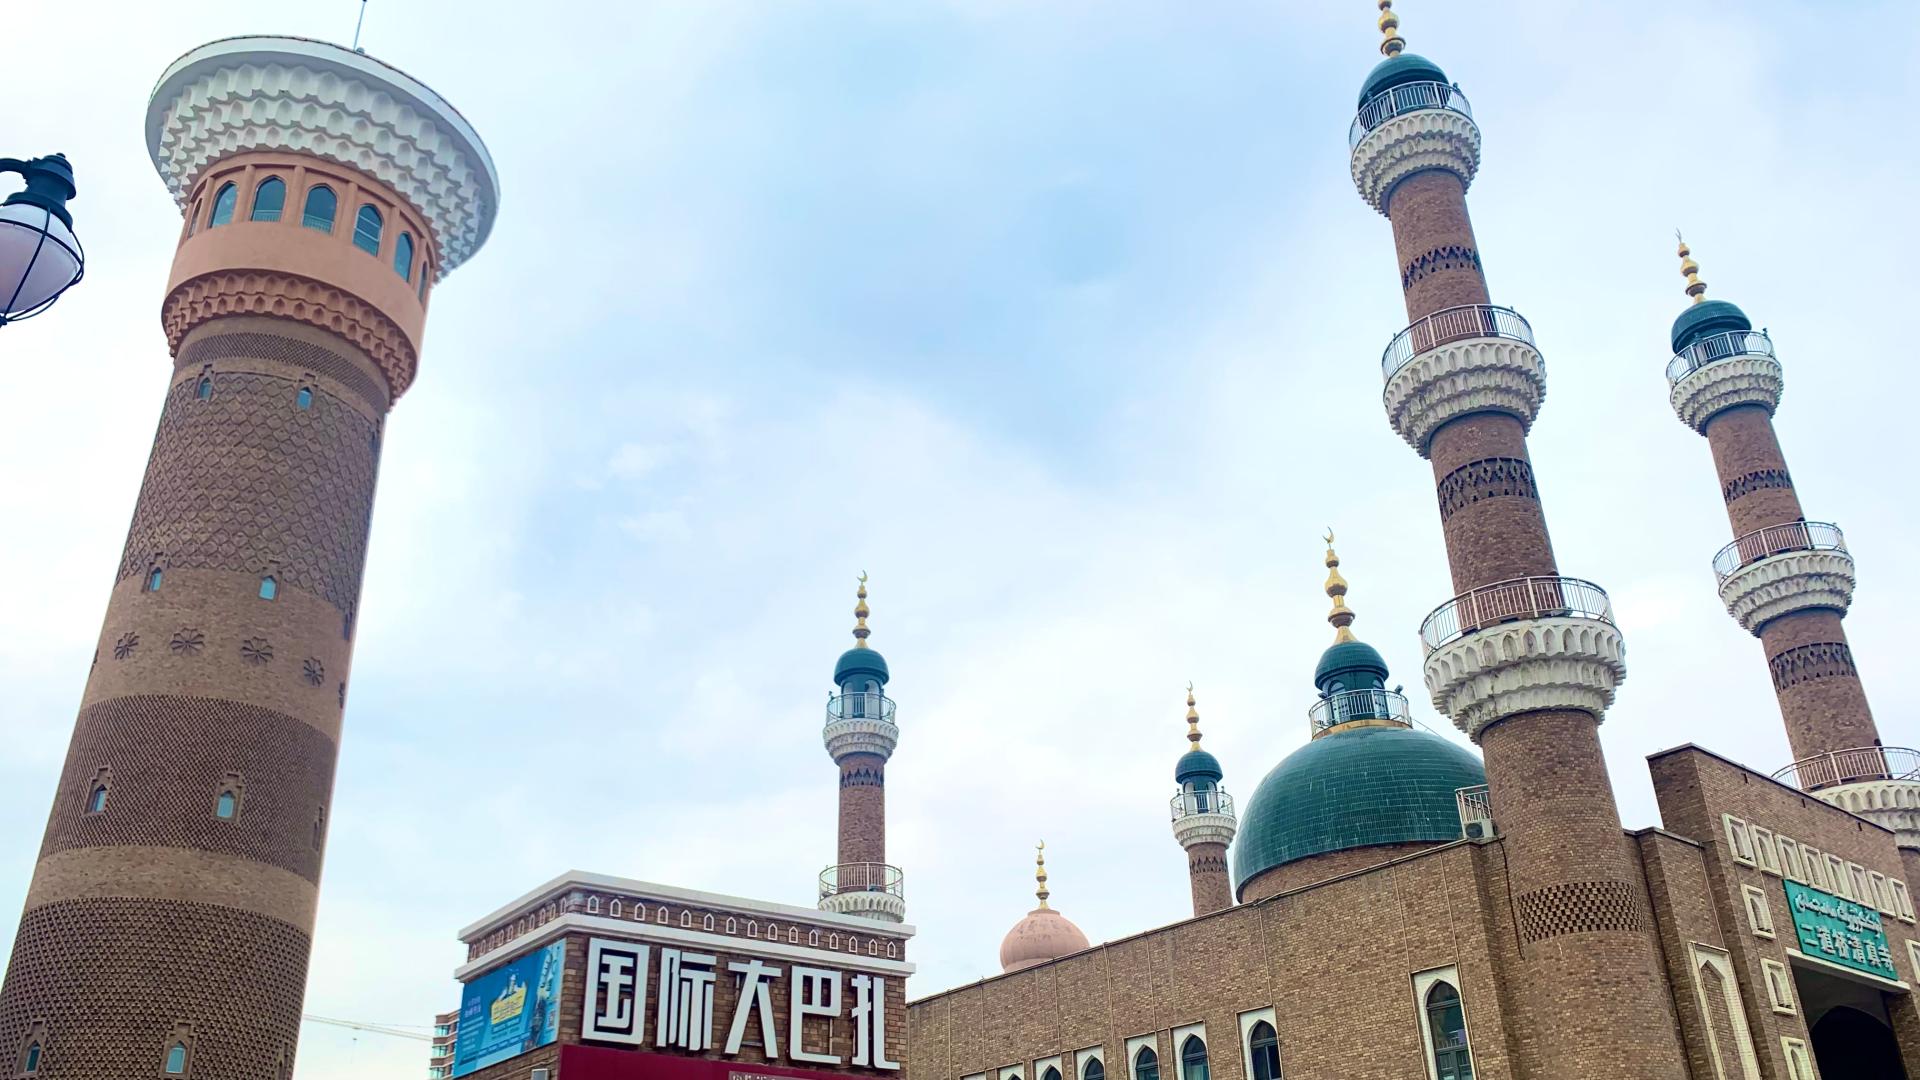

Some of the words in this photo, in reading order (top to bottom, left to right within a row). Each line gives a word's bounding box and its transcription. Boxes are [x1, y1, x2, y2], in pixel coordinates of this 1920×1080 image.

[582, 937, 900, 1070] 国际大巴扎
